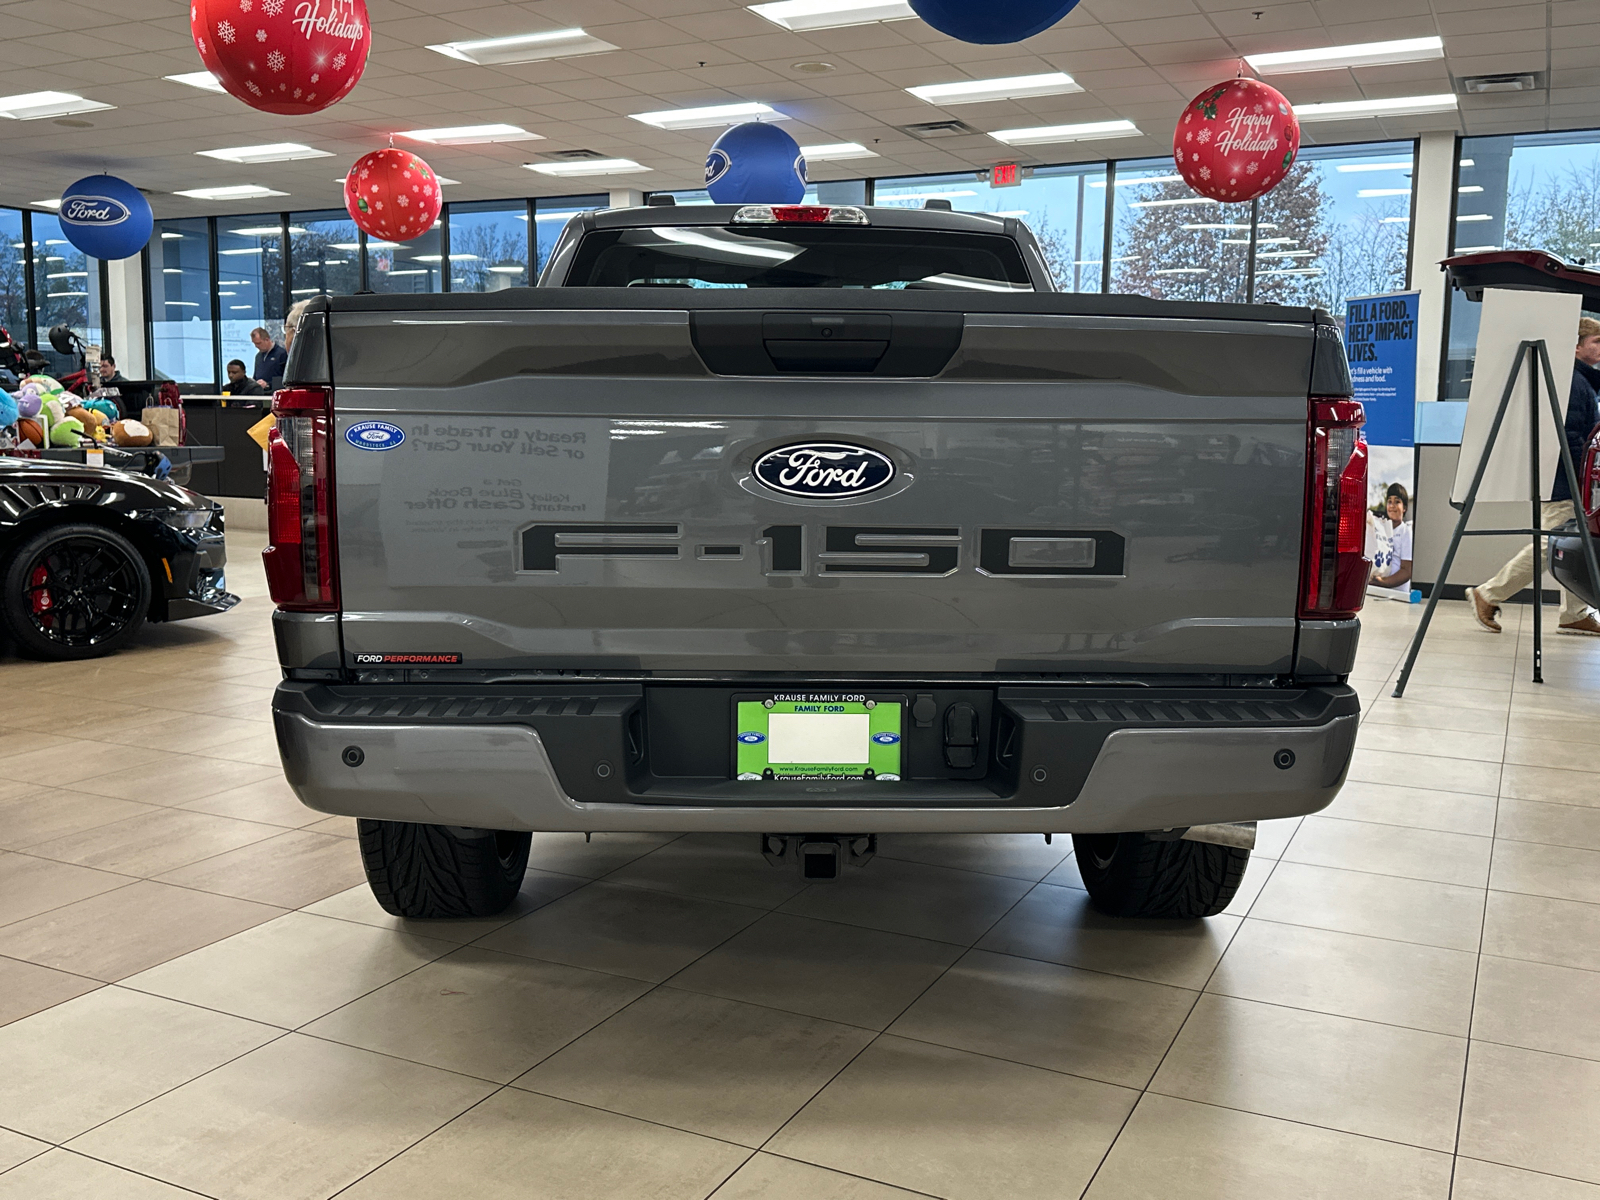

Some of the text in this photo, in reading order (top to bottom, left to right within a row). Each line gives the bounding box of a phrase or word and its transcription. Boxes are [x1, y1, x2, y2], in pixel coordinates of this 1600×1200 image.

[292, 2, 363, 51] Holidays
[1225, 106, 1274, 134] Happy
[1214, 130, 1279, 159] Holidays
[994, 164, 1017, 185] EXIT
[67, 200, 111, 220] Ford
[1349, 301, 1410, 323] FILL A FORD.
[1348, 320, 1414, 343] HELP IMPACT
[1347, 343, 1378, 363] LIVES.
[366, 432, 385, 440] Ford
[779, 449, 869, 488] Ford
[517, 523, 1126, 577] F-150
[357, 654, 458, 663] FORD PERFORMANCE
[809, 694, 839, 702] FAMILY
